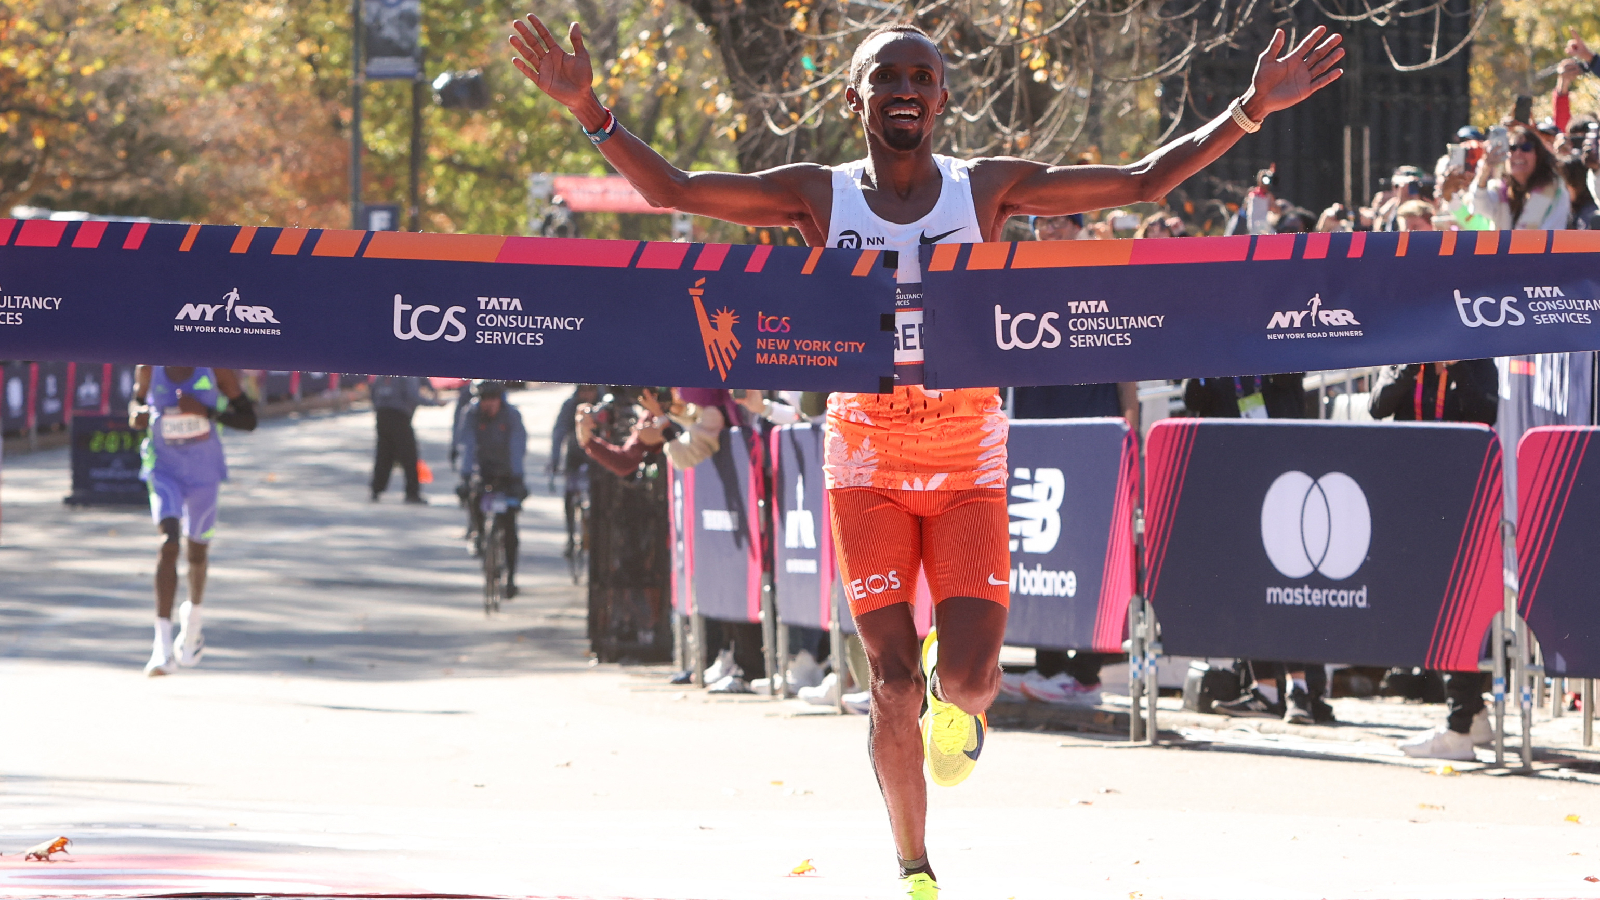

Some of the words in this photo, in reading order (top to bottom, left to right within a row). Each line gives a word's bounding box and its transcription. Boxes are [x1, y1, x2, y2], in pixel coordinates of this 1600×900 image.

[866, 236, 885, 246] NN
[1523, 286, 1566, 299] TATA
[476, 296, 523, 311] TATA
[1067, 300, 1110, 314] TATA
[1453, 288, 1526, 328] tcs
[393, 293, 467, 343] tcs
[476, 313, 585, 331] CONSULTANCY
[757, 310, 791, 334] tcs
[1068, 315, 1165, 332] CONSULTANCY
[1532, 312, 1592, 325] SERVICES
[173, 324, 193, 332] NEW
[194, 325, 217, 334] YORK
[218, 326, 242, 335] ROAD
[243, 327, 281, 336] RUNNERS
[994, 304, 1062, 351] tcs
[1285, 332, 1306, 340] YORK
[1306, 331, 1328, 339] ROAD
[1328, 330, 1364, 338] RUNNERS
[475, 330, 544, 346] SERVICES
[756, 338, 791, 351] NEW
[793, 339, 832, 352] YORK
[834, 341, 866, 353] CITY
[1069, 332, 1132, 348] SERVICES
[755, 352, 839, 367] MARATHON
[1018, 562, 1077, 597] balance
[1265, 584, 1367, 608] mastercard
